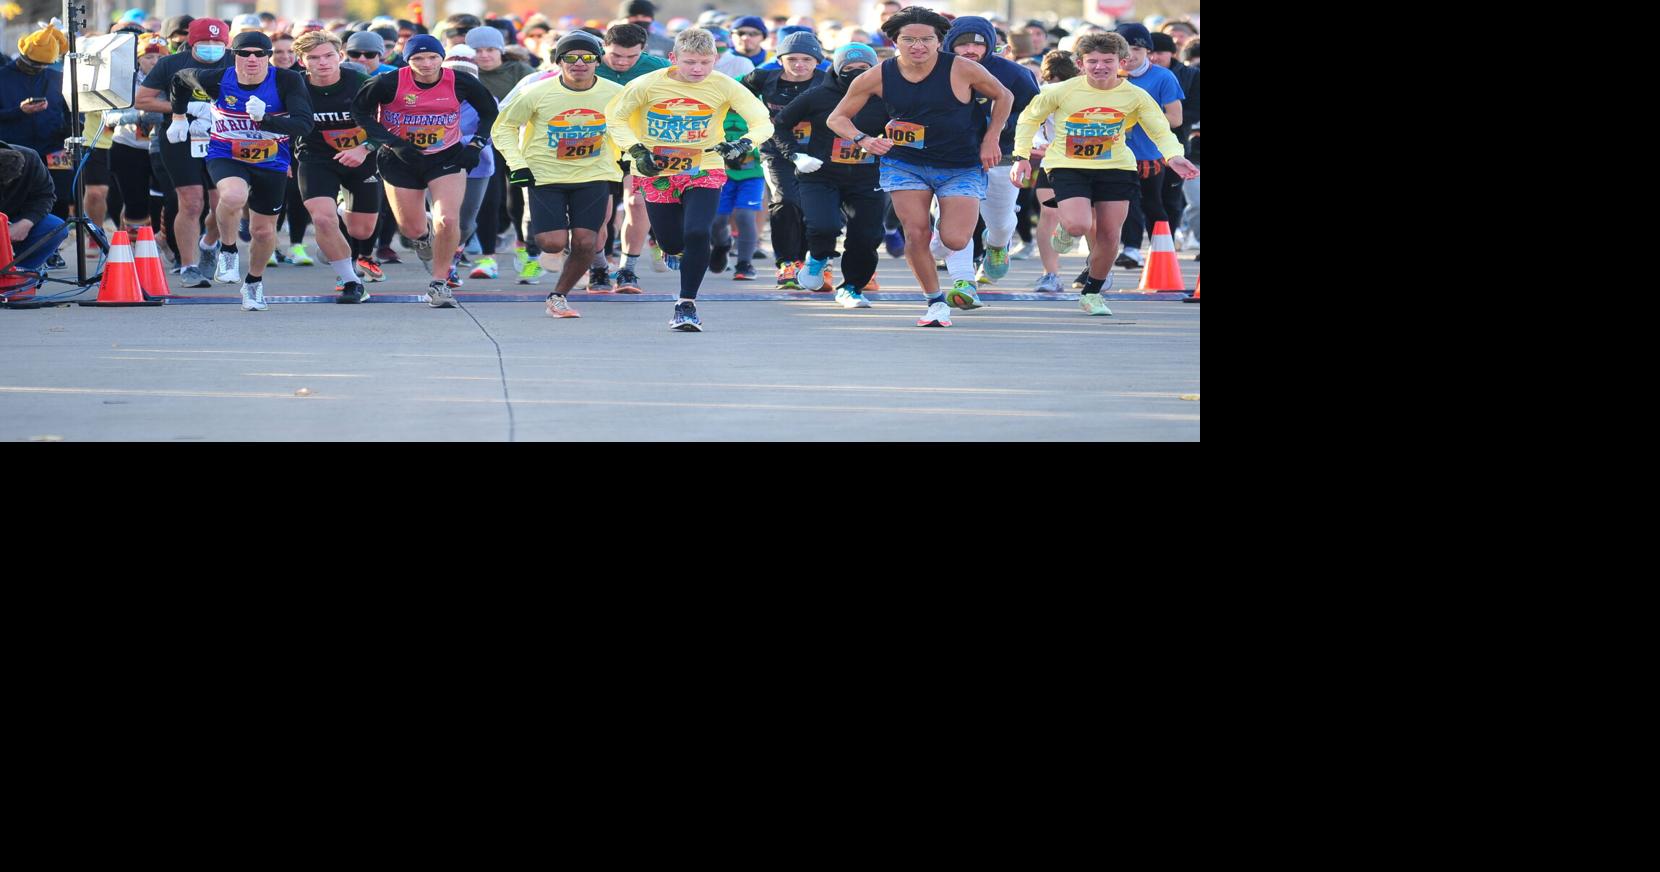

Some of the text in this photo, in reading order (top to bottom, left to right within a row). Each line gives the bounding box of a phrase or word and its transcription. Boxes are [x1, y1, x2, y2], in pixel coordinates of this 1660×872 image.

[647, 118, 712, 131] TURKEY
[406, 132, 438, 145] 336
[648, 128, 685, 140] DAY
[887, 128, 916, 142] 106
[333, 135, 360, 148] 121
[240, 147, 270, 160] 321
[565, 145, 594, 157] 261
[1073, 144, 1104, 156] 287
